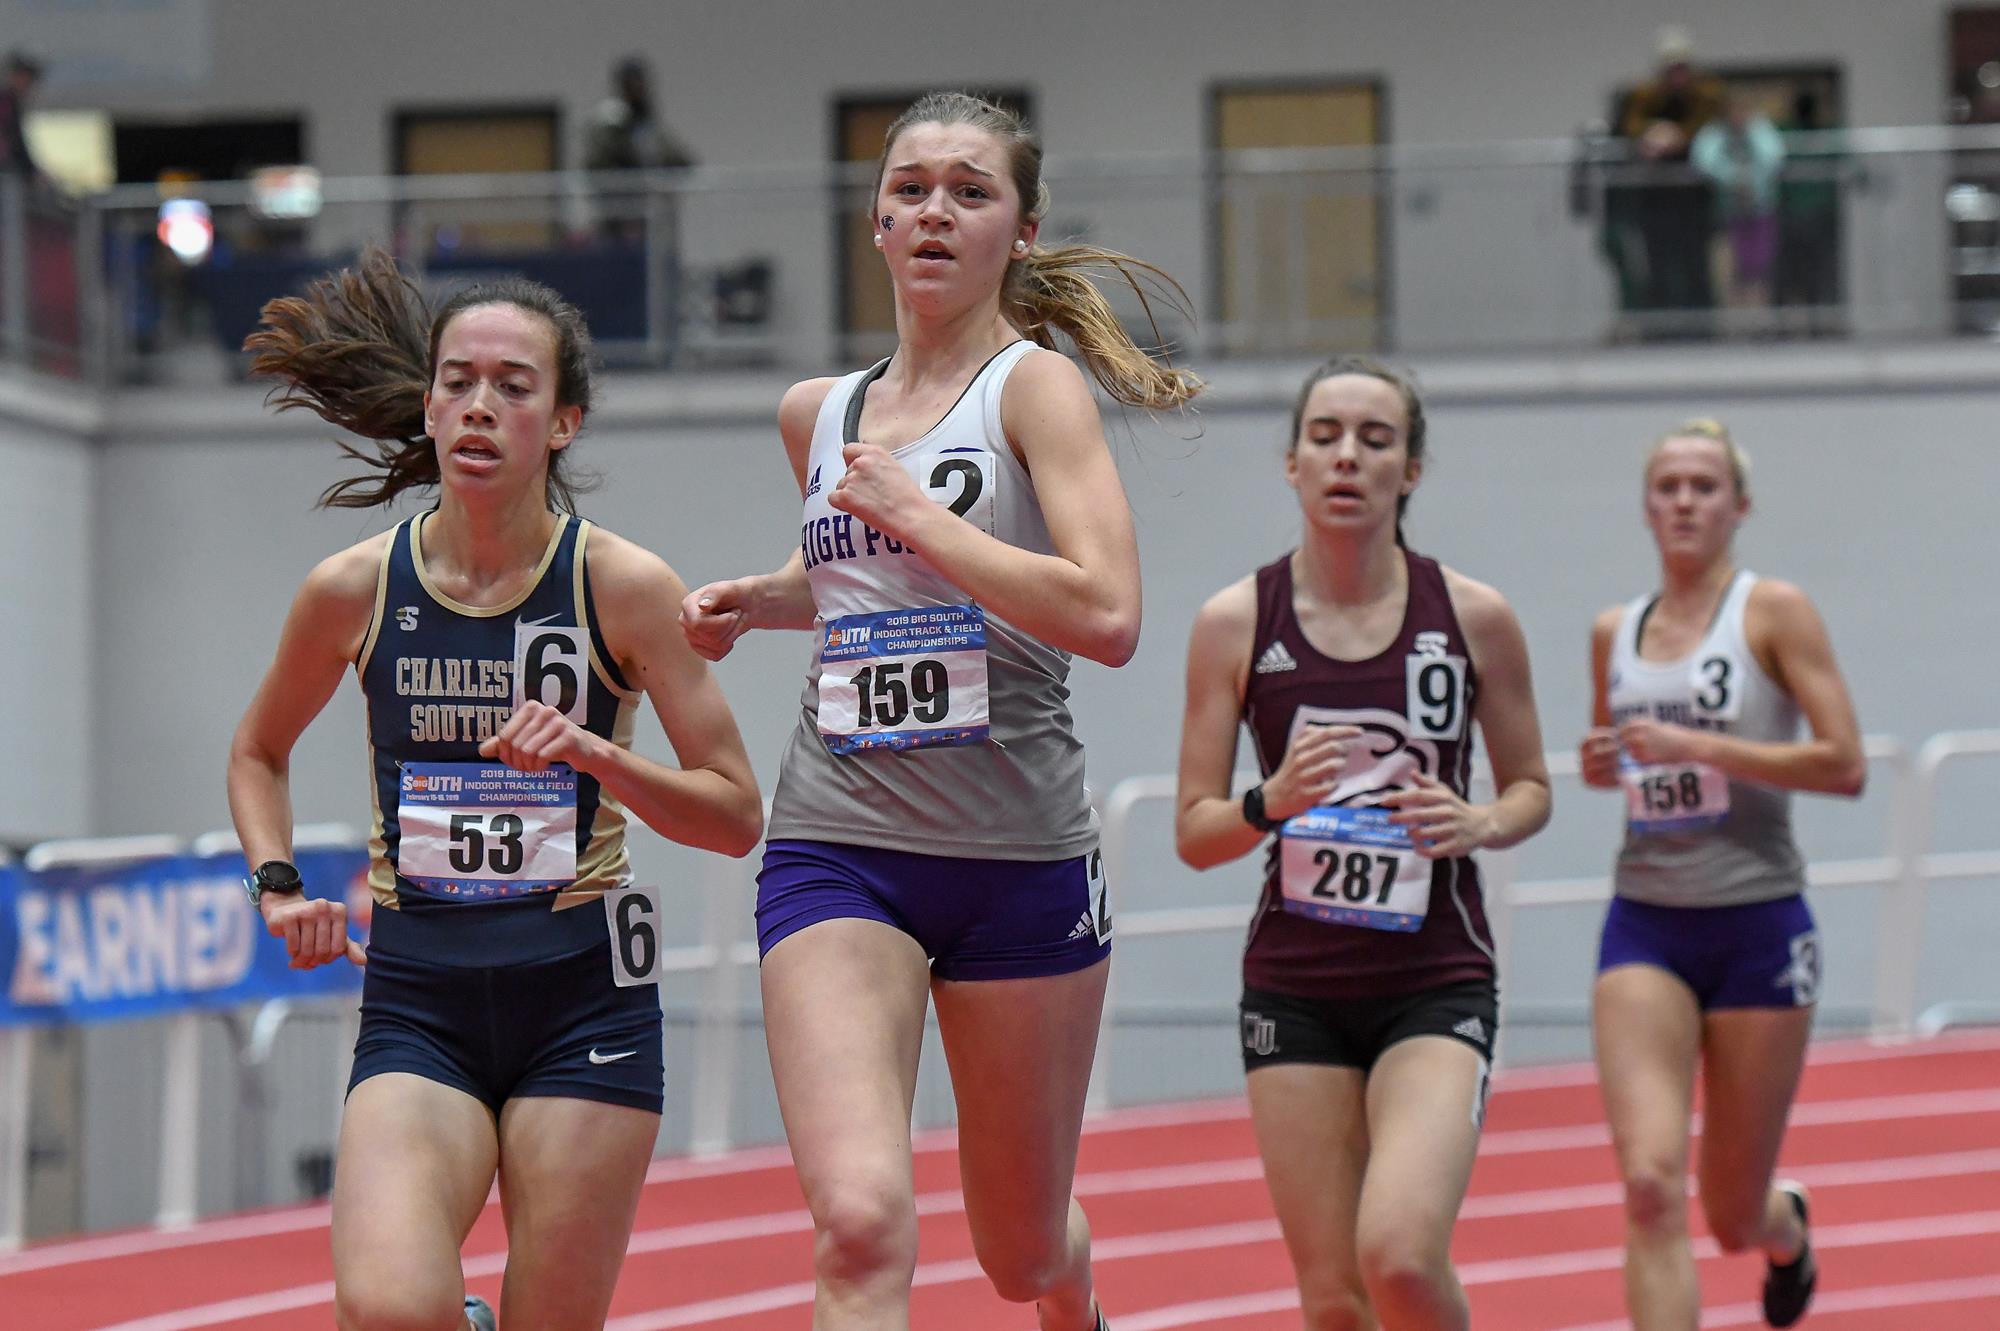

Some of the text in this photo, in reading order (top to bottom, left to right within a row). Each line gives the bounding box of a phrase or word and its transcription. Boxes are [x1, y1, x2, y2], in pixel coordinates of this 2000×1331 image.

[801, 514, 857, 572] HIGH
[873, 623, 983, 639] INDOOR TRACK & FIELD
[886, 612, 964, 626] 2019 BIG SOUTH
[887, 636, 968, 650] CHAMPIONSHIPS
[396, 657, 514, 698] CHARLES
[523, 632, 578, 722] 6
[850, 660, 950, 728] 159
[1419, 663, 1455, 733] 9
[1698, 657, 1731, 711] 3
[464, 781, 574, 791] INDOOR TRACK & FIELD
[479, 793, 560, 802] CHAMPIONSHIPS
[480, 769, 559, 779] 2019 BIG SOUTH
[1640, 771, 1702, 812] 158
[448, 813, 524, 875] 53
[1312, 848, 1400, 905] 287
[9, 875, 256, 1006] EARNED
[616, 893, 656, 979] 6
